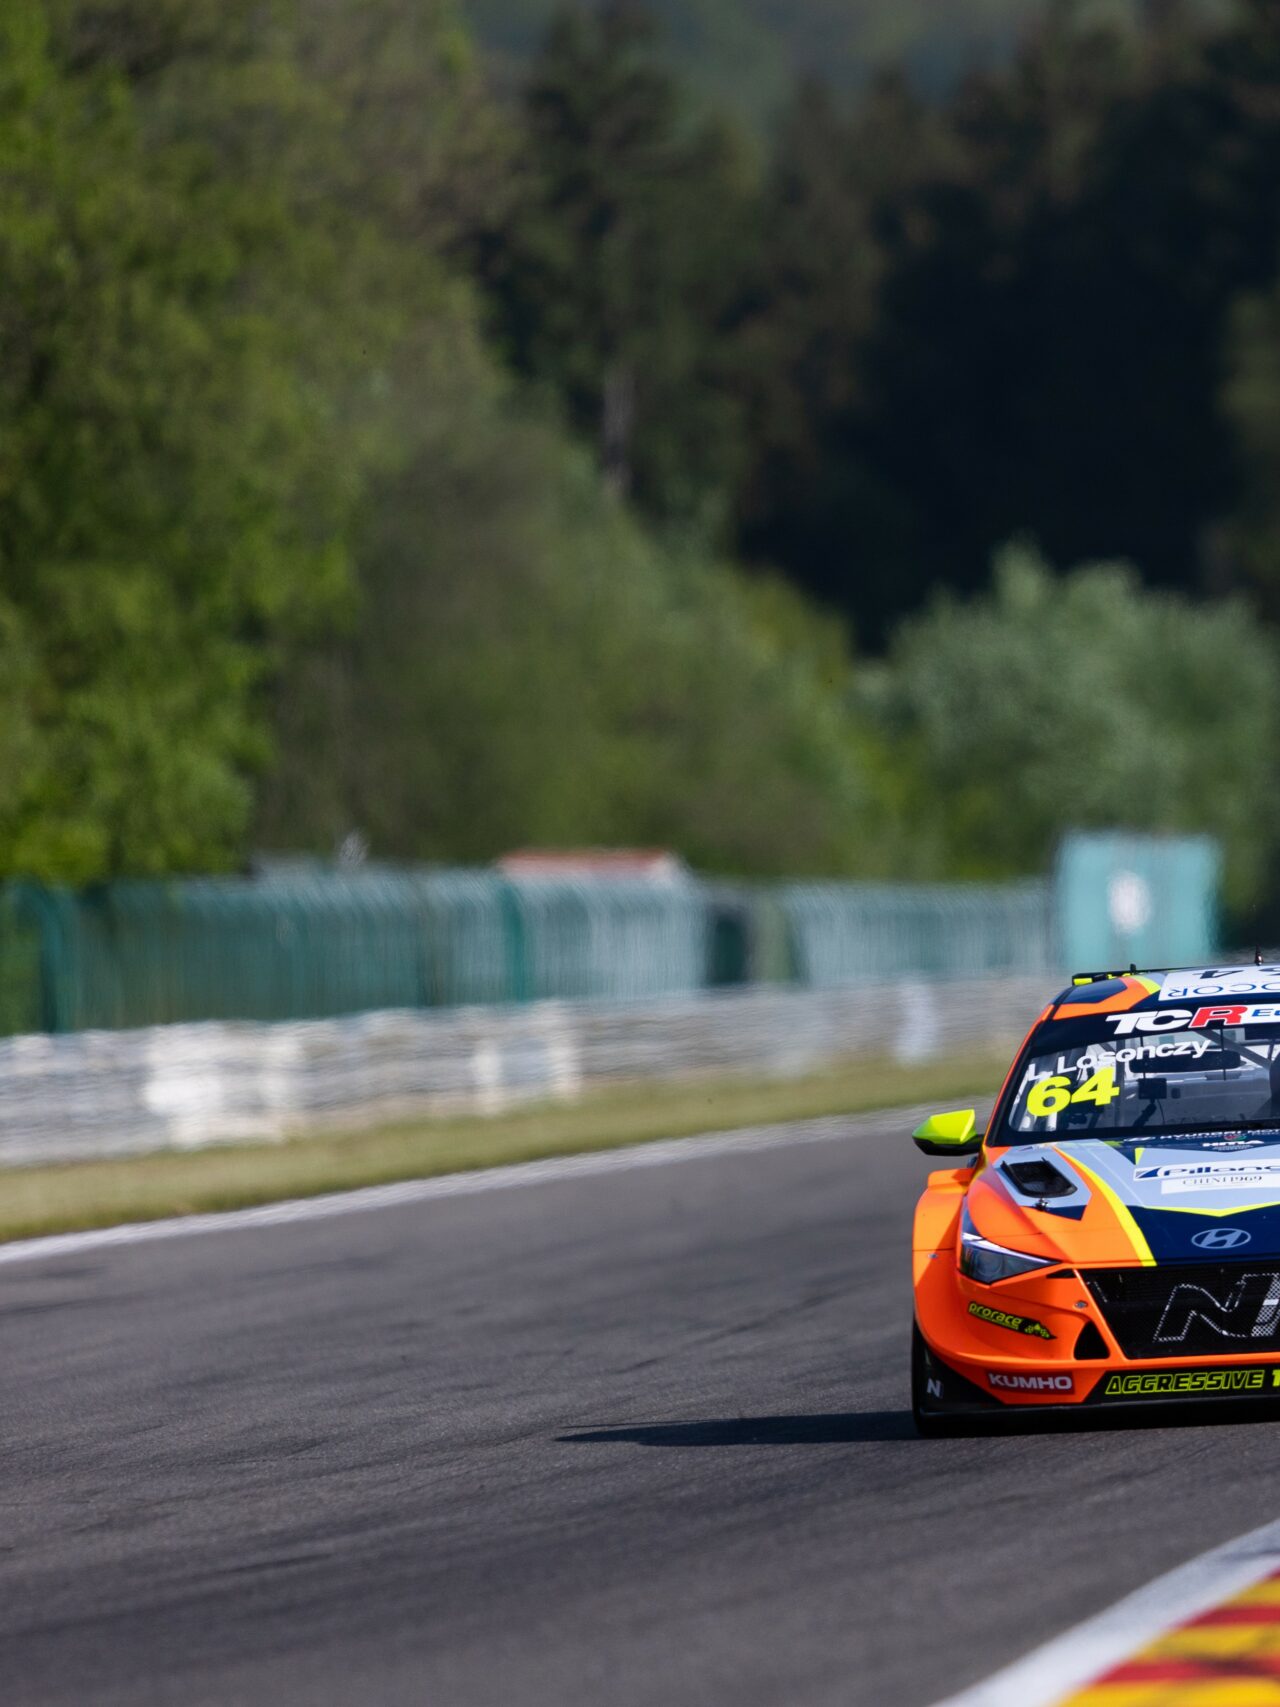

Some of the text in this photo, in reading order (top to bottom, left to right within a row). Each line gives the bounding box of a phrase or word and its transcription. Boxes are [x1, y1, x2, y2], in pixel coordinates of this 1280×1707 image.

[1105, 1005, 1248, 1035] TCR
[1057, 1039, 1211, 1074] Losonczy
[1026, 1066, 1120, 1117] 64
[968, 1302, 1022, 1327] prorace
[988, 1372, 1072, 1390] KUMHO
[1105, 1369, 1265, 1395] AGGRESSIVE
